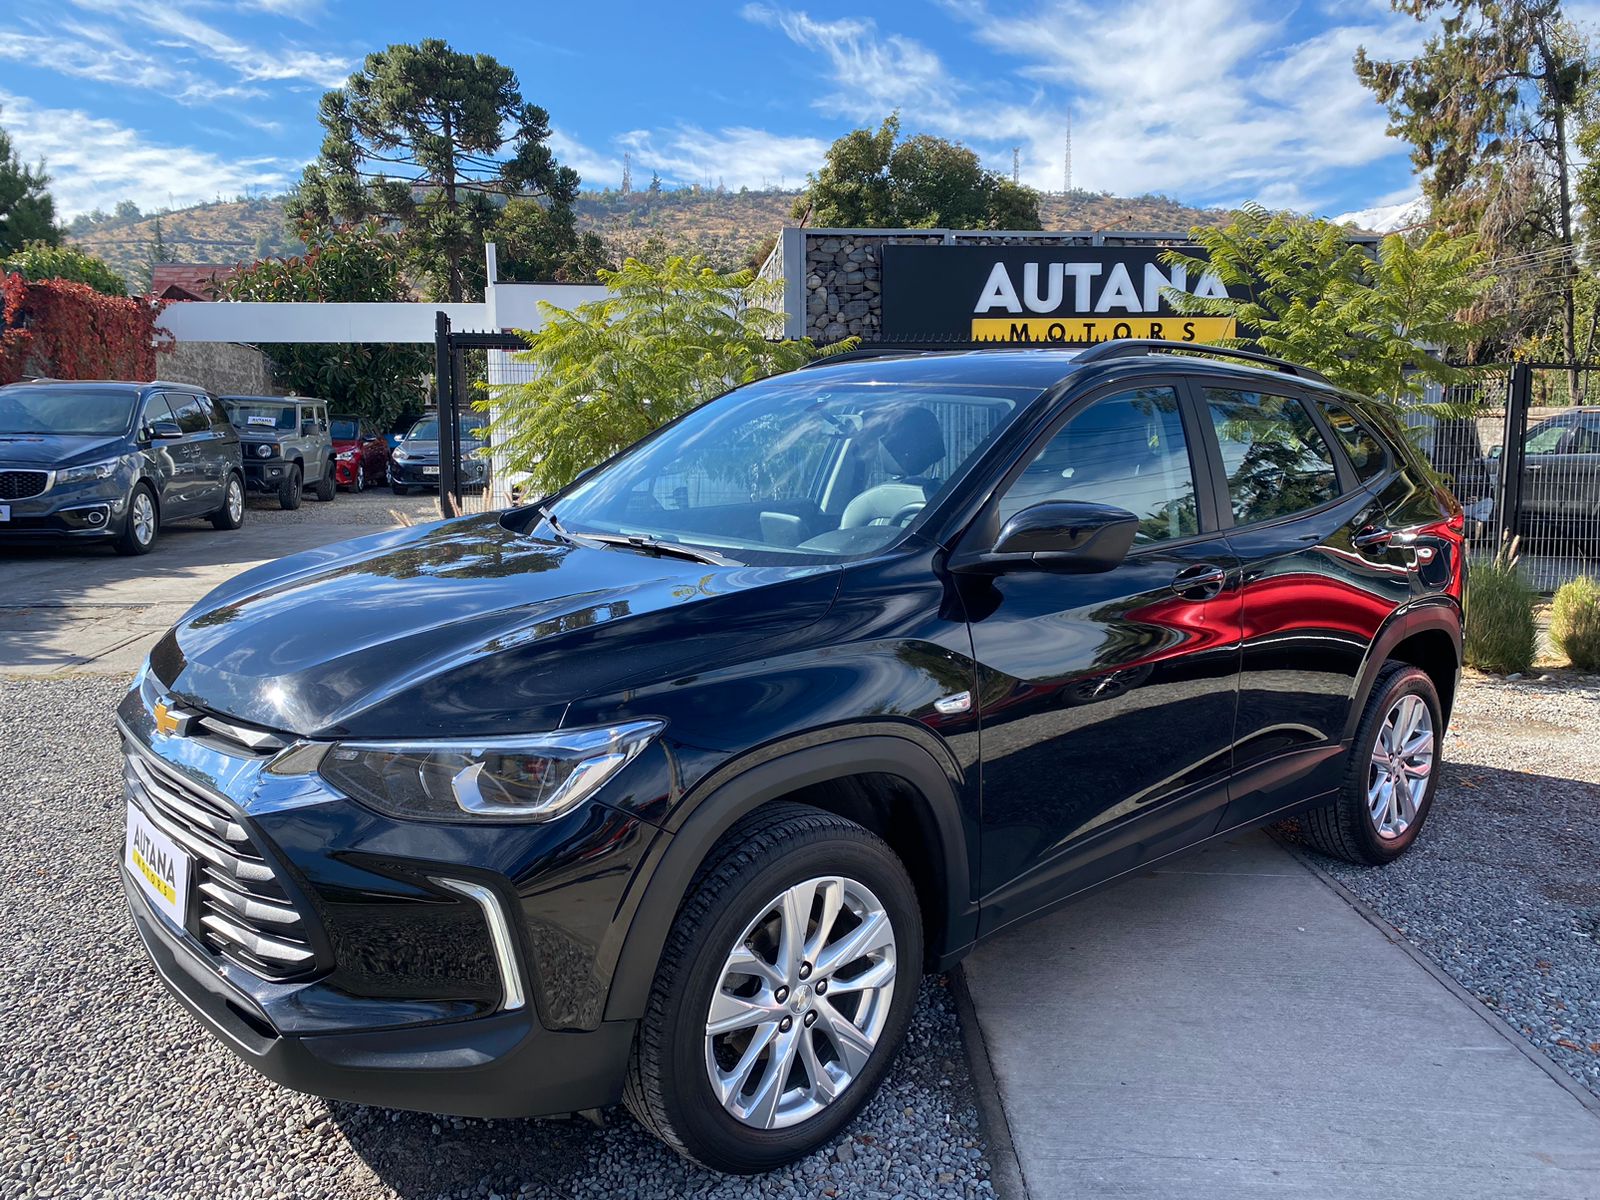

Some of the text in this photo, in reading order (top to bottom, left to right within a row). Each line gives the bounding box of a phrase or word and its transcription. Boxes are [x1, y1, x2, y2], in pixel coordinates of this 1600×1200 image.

[974, 262, 1231, 313] AUTANA
[1010, 322, 1196, 342] MOTORS
[133, 824, 176, 888] AUTANA
[136, 856, 168, 896] MOTORS
